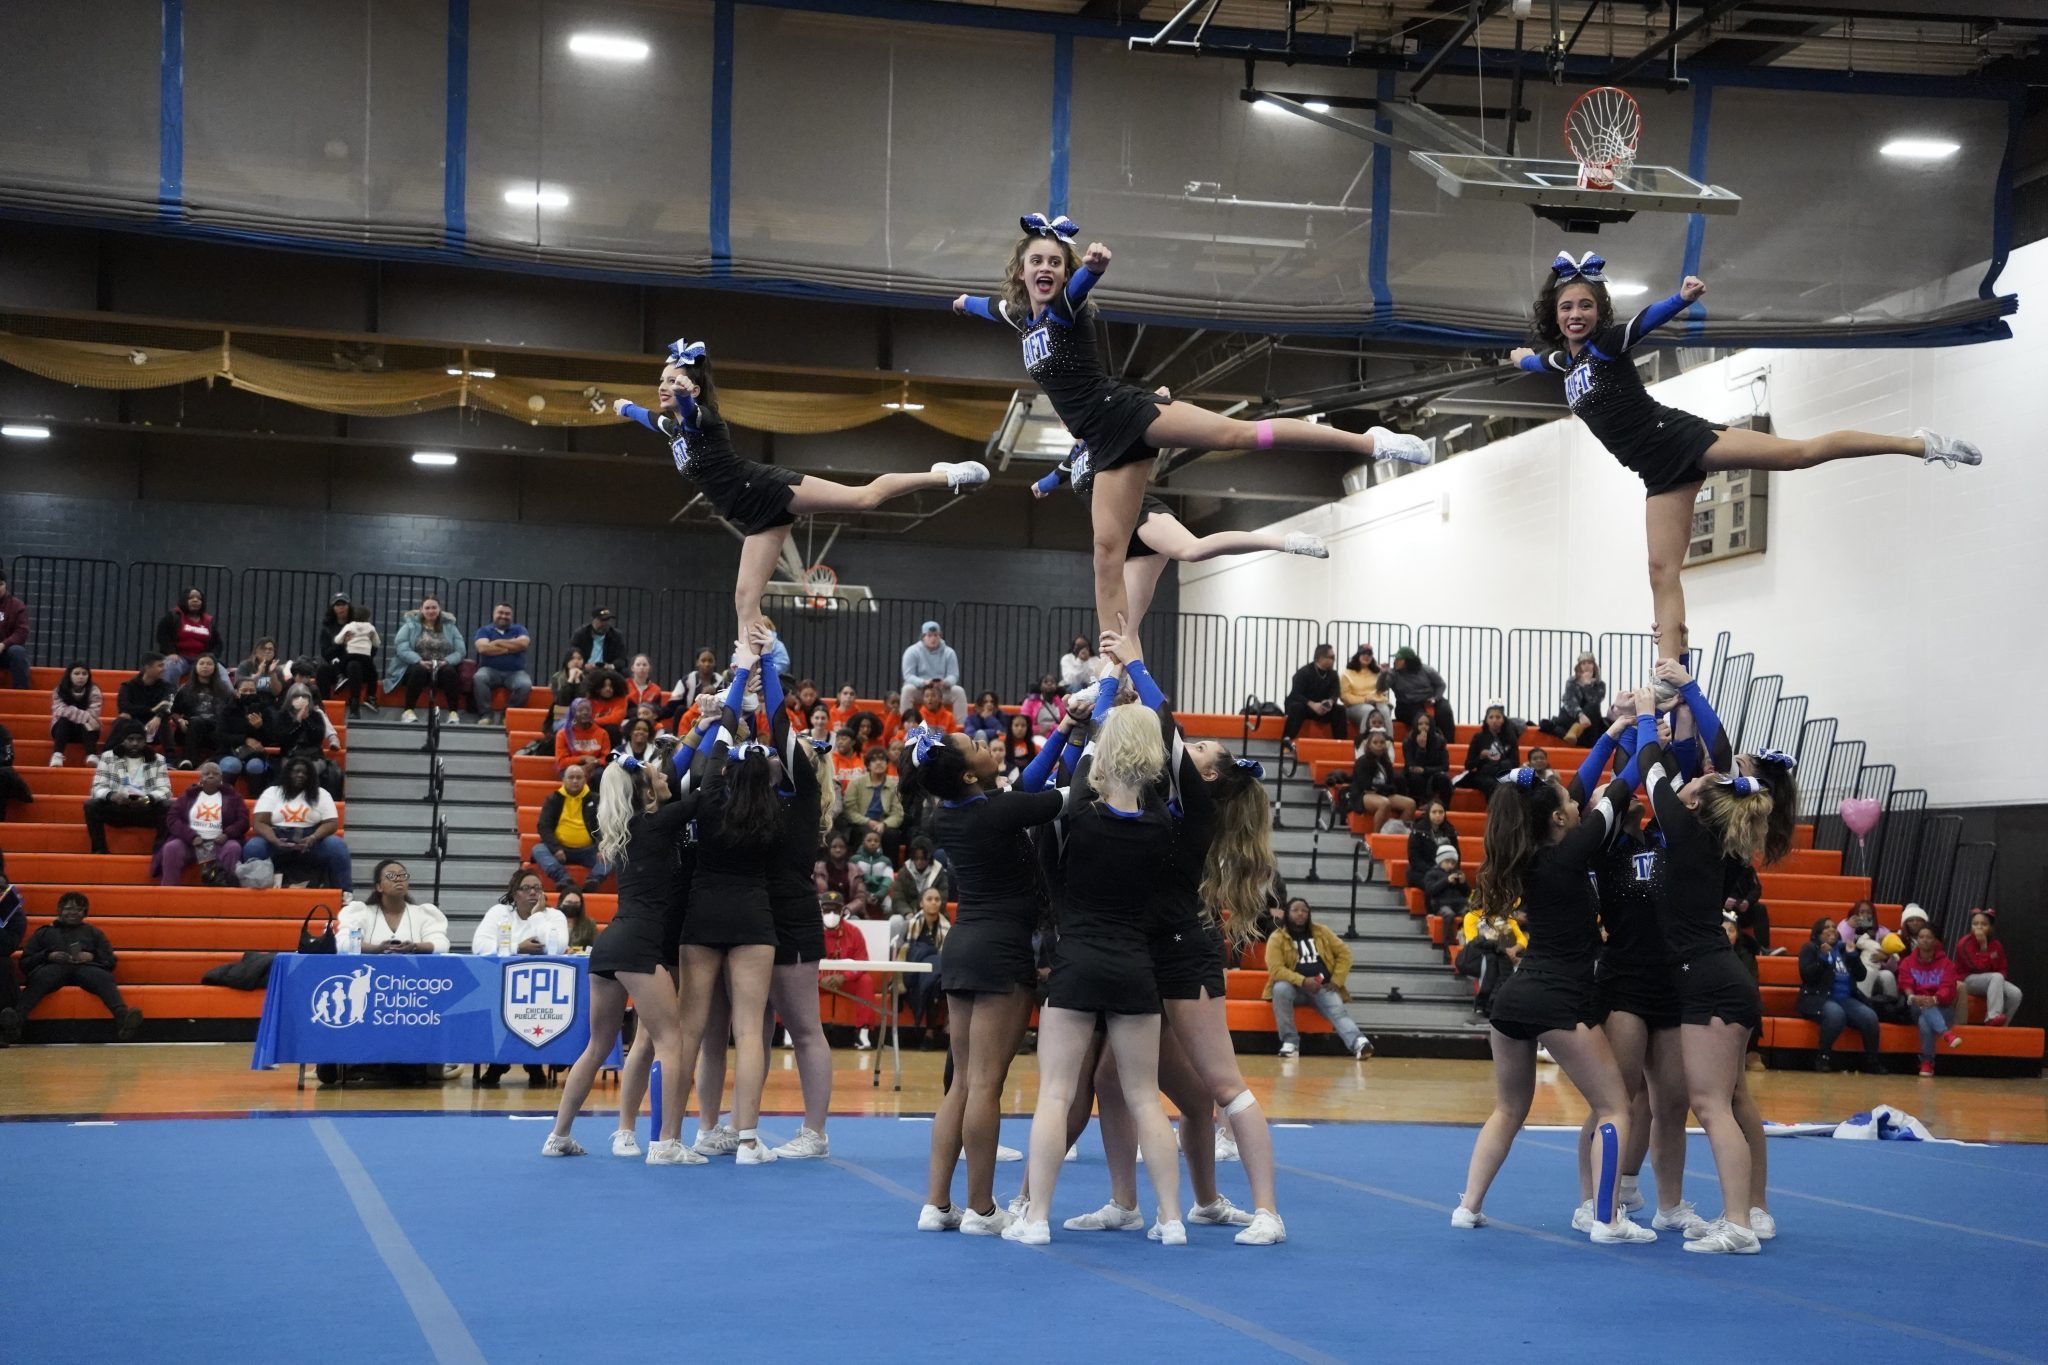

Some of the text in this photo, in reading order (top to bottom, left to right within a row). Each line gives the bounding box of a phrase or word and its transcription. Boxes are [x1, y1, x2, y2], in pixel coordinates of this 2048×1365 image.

[374, 974, 453, 994] Chicago
[510, 968, 569, 1005] CPL
[374, 992, 429, 1008] Public
[372, 1010, 441, 1026] Schools
